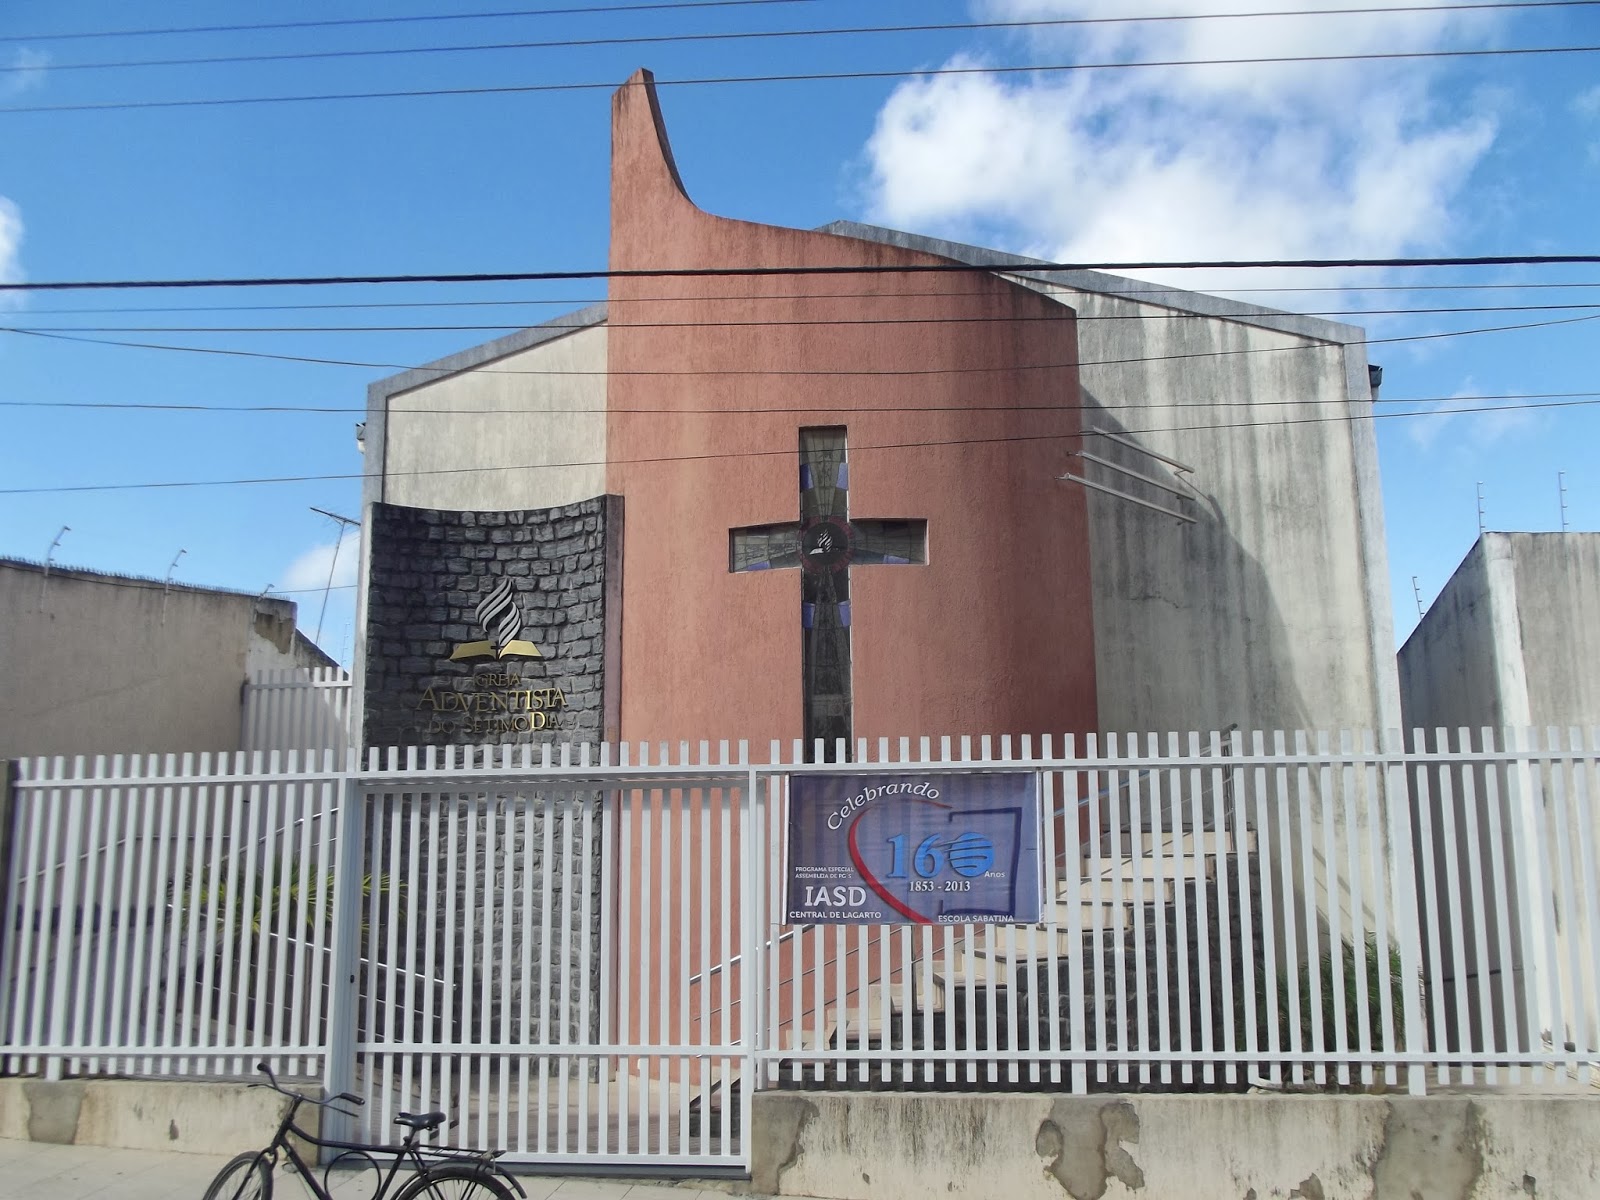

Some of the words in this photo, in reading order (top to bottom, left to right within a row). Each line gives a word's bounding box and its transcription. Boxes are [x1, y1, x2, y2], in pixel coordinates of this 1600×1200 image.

[416, 686, 567, 712] ADVENTISTA
[429, 720, 456, 734] DO
[529, 711, 561, 730] DIA
[827, 782, 940, 830] Celebrando
[984, 870, 1006, 878] Anos
[909, 880, 934, 892] 1853
[944, 880, 971, 892] 2013
[804, 885, 867, 907] IASD
[789, 911, 828, 919] CENTRAL
[829, 911, 841, 919] DE
[842, 911, 882, 919] LAGARTO
[938, 914, 971, 923] ESCOLA
[972, 914, 1014, 922] SABATINA
